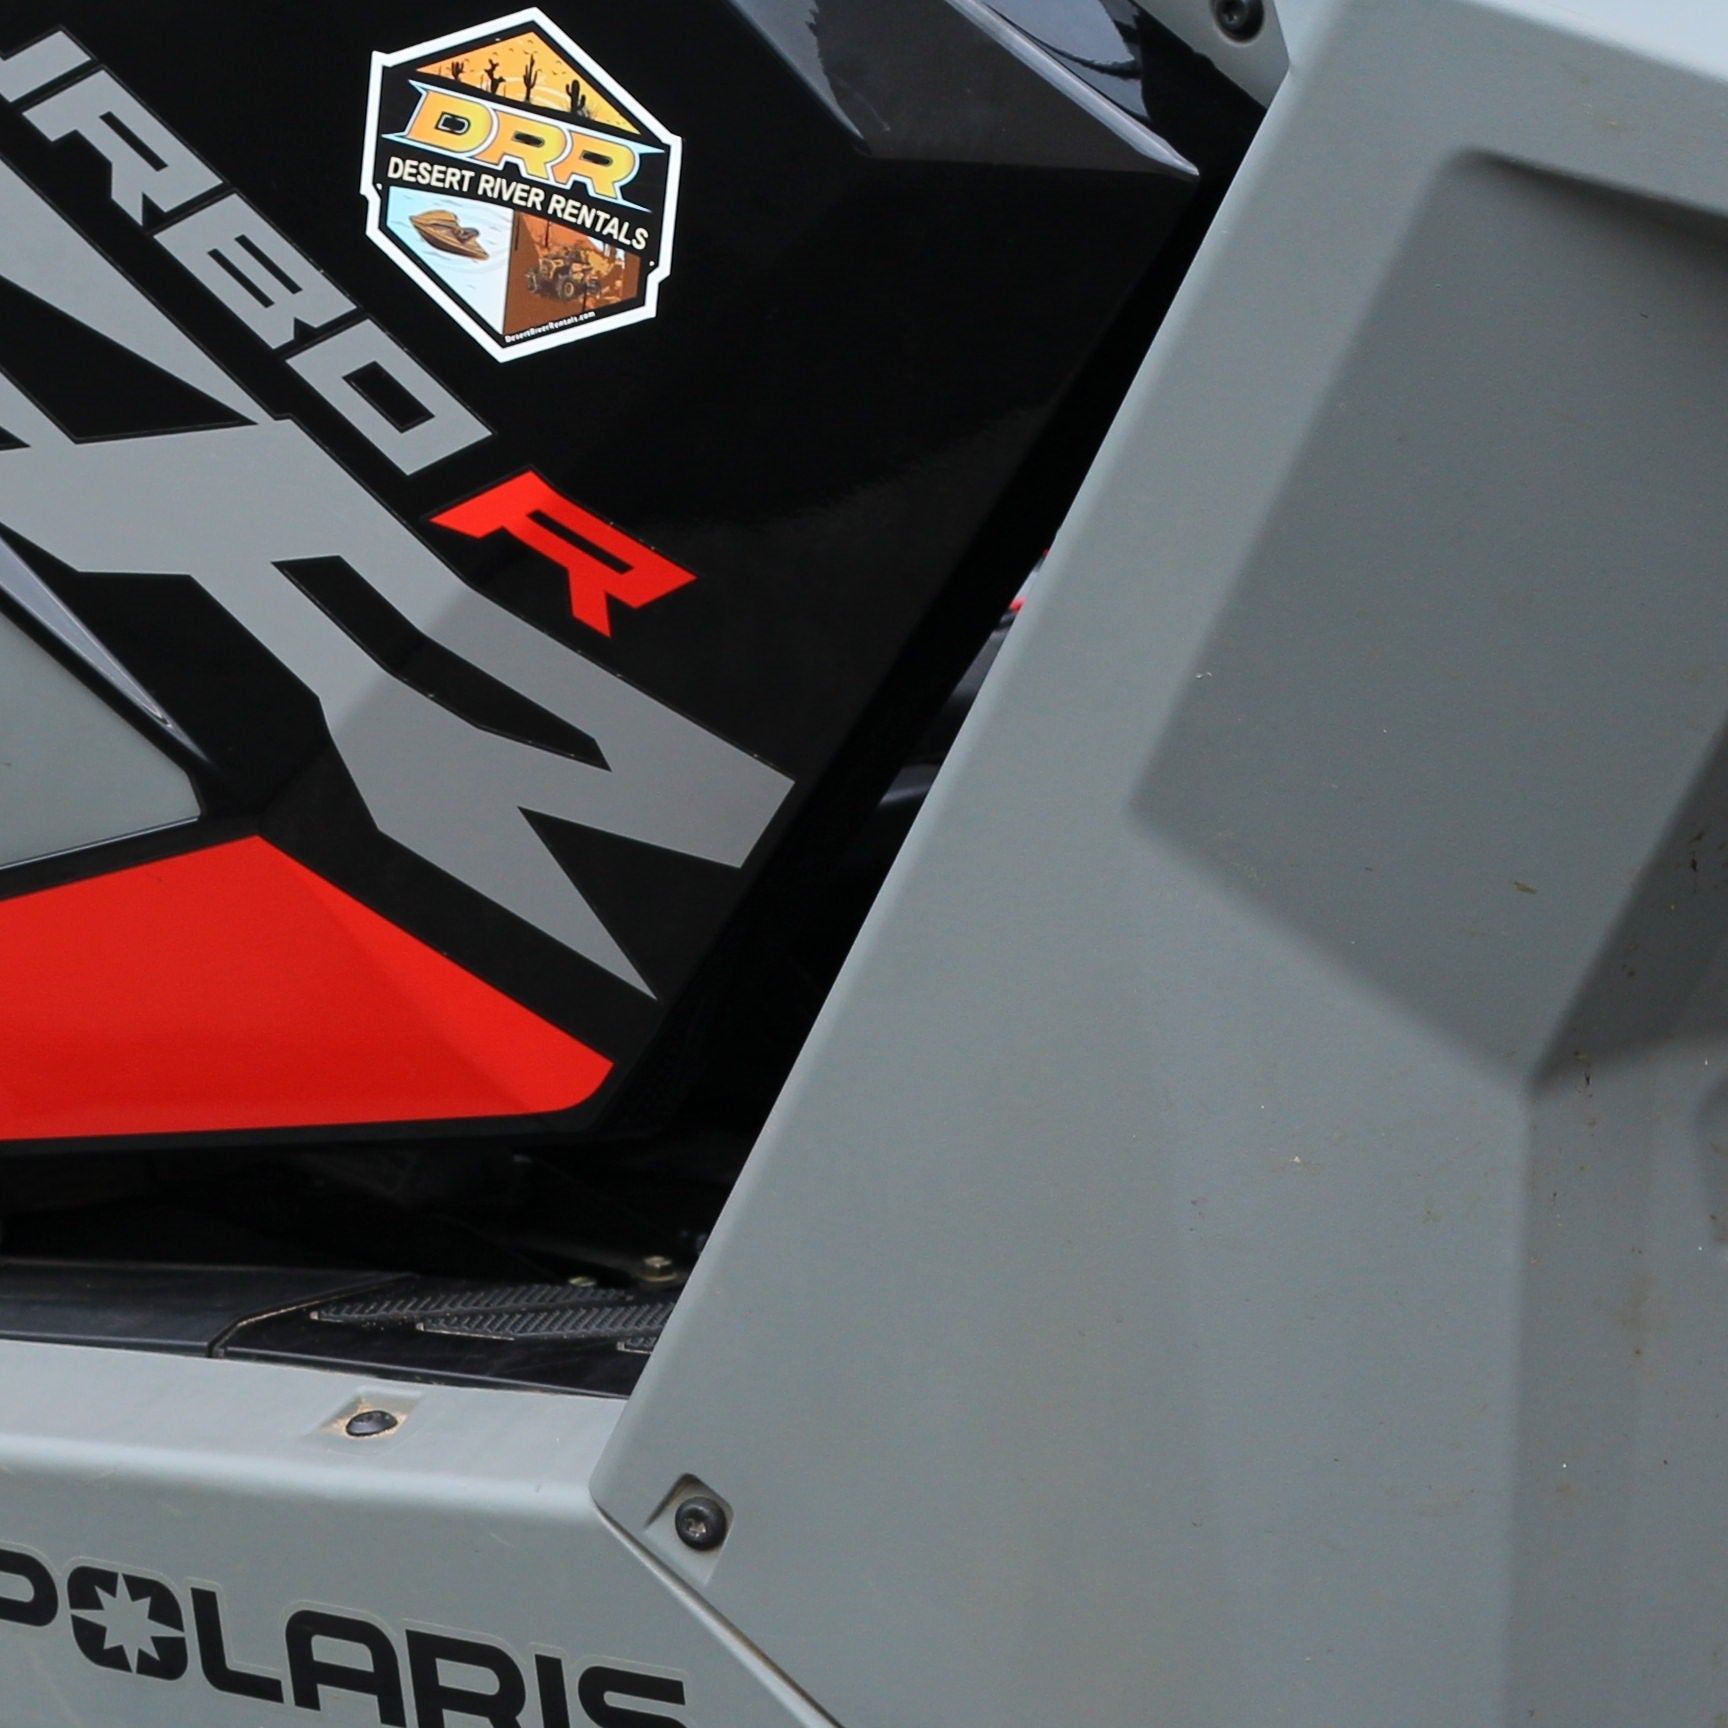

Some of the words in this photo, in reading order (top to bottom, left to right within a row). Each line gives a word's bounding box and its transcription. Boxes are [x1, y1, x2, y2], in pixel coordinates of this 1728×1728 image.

[405, 88, 636, 200] DRR
[387, 157, 475, 193] DESERT
[477, 174, 543, 212] RIVER
[547, 193, 649, 250] RENTALS
[429, 468, 698, 638] R
